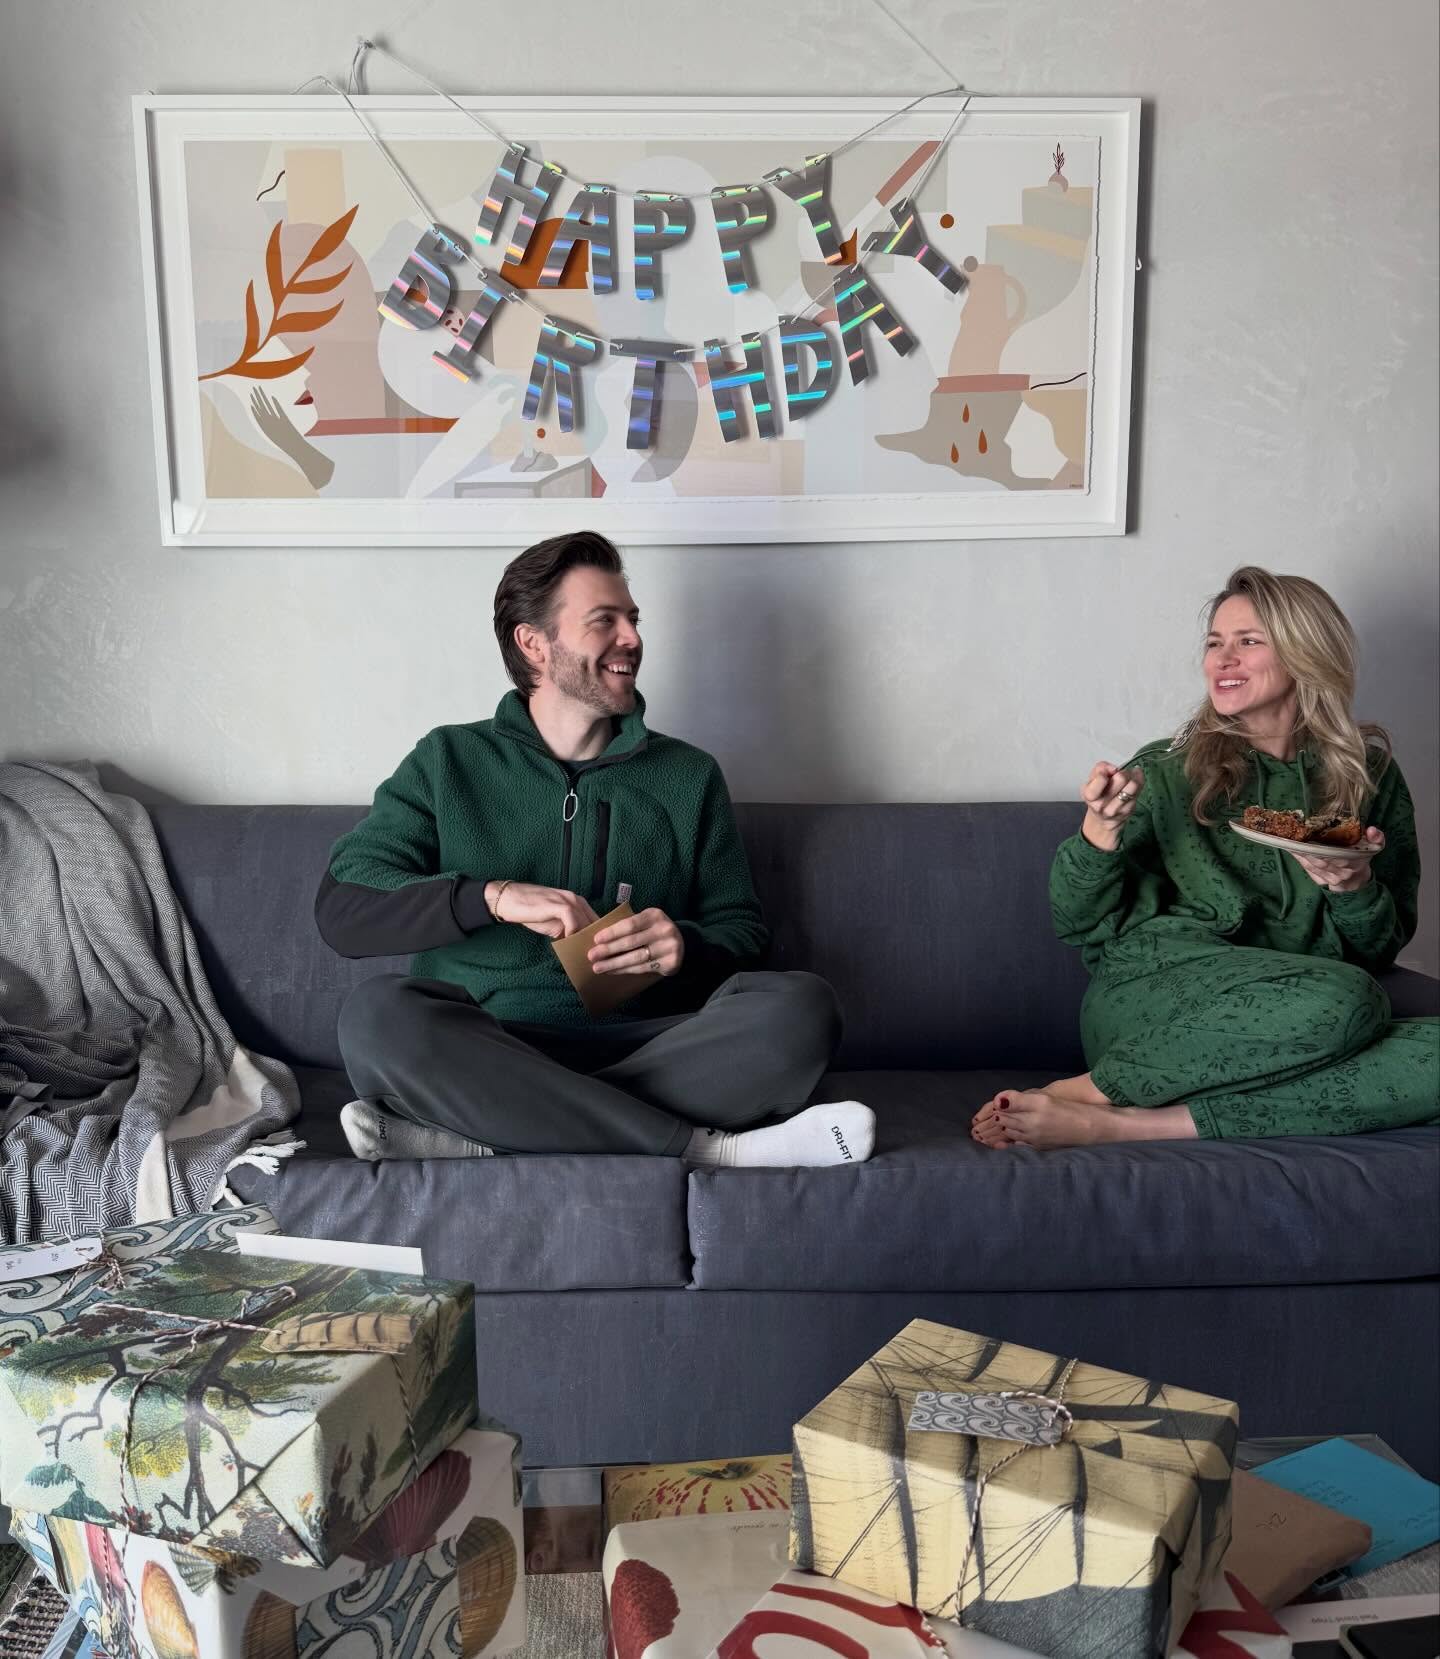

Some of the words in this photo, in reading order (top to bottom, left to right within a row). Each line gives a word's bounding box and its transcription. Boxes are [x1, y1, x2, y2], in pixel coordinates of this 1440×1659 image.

[474, 142, 842, 300] HAPPY
[378, 198, 968, 450] BIRTHDAY
[831, 1125, 853, 1160] DRI-FIT
